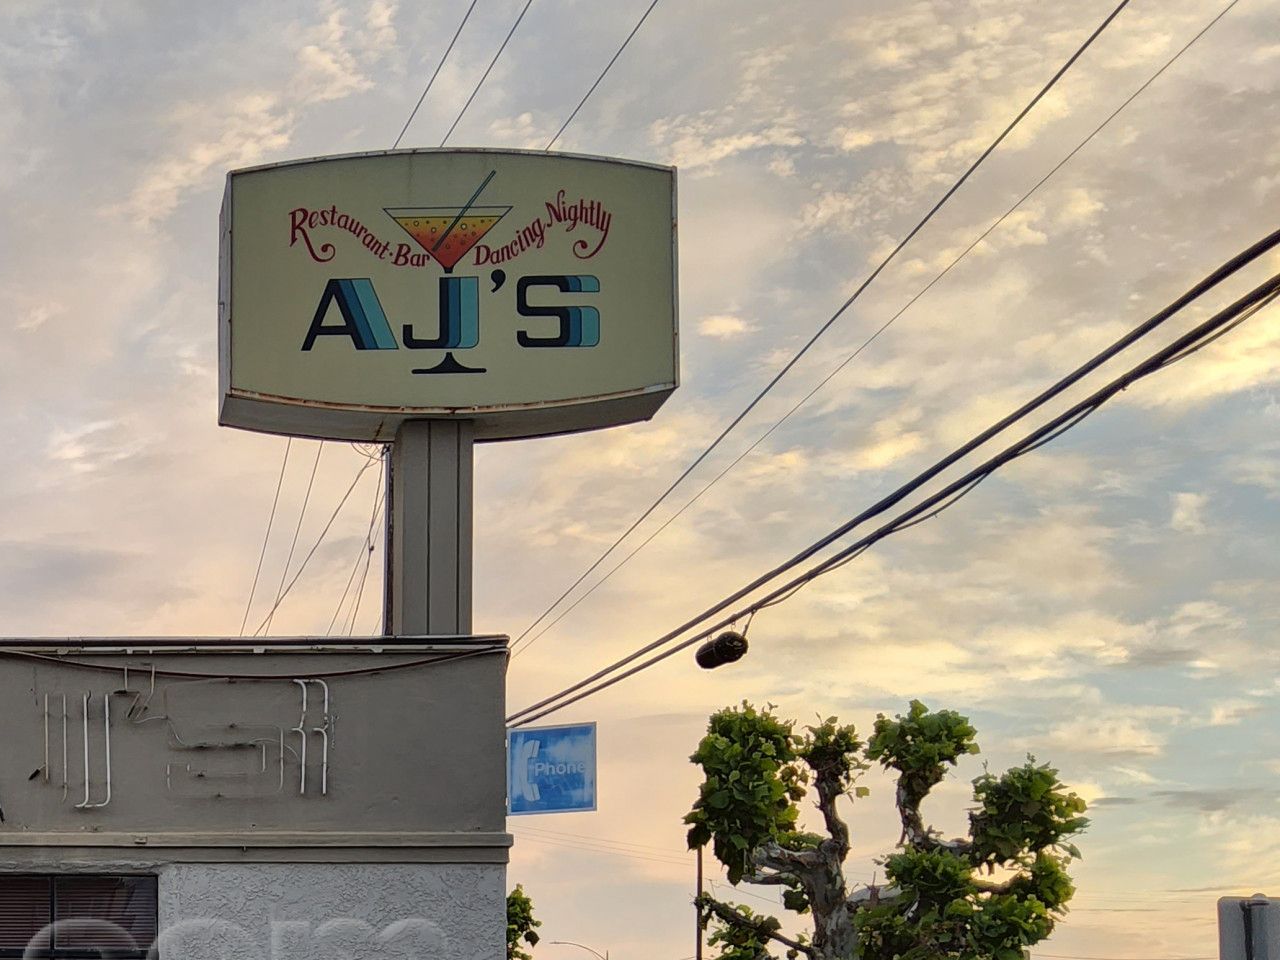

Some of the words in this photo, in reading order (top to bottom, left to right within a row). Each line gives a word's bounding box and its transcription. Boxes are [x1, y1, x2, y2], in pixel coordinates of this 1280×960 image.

[288, 205, 391, 263] Restaurant
[392, 243, 431, 267] Bar
[473, 217, 547, 266] Dancing
[545, 189, 613, 260] Nightly
[301, 269, 601, 352] AJ'S
[534, 761, 585, 777] Phone
